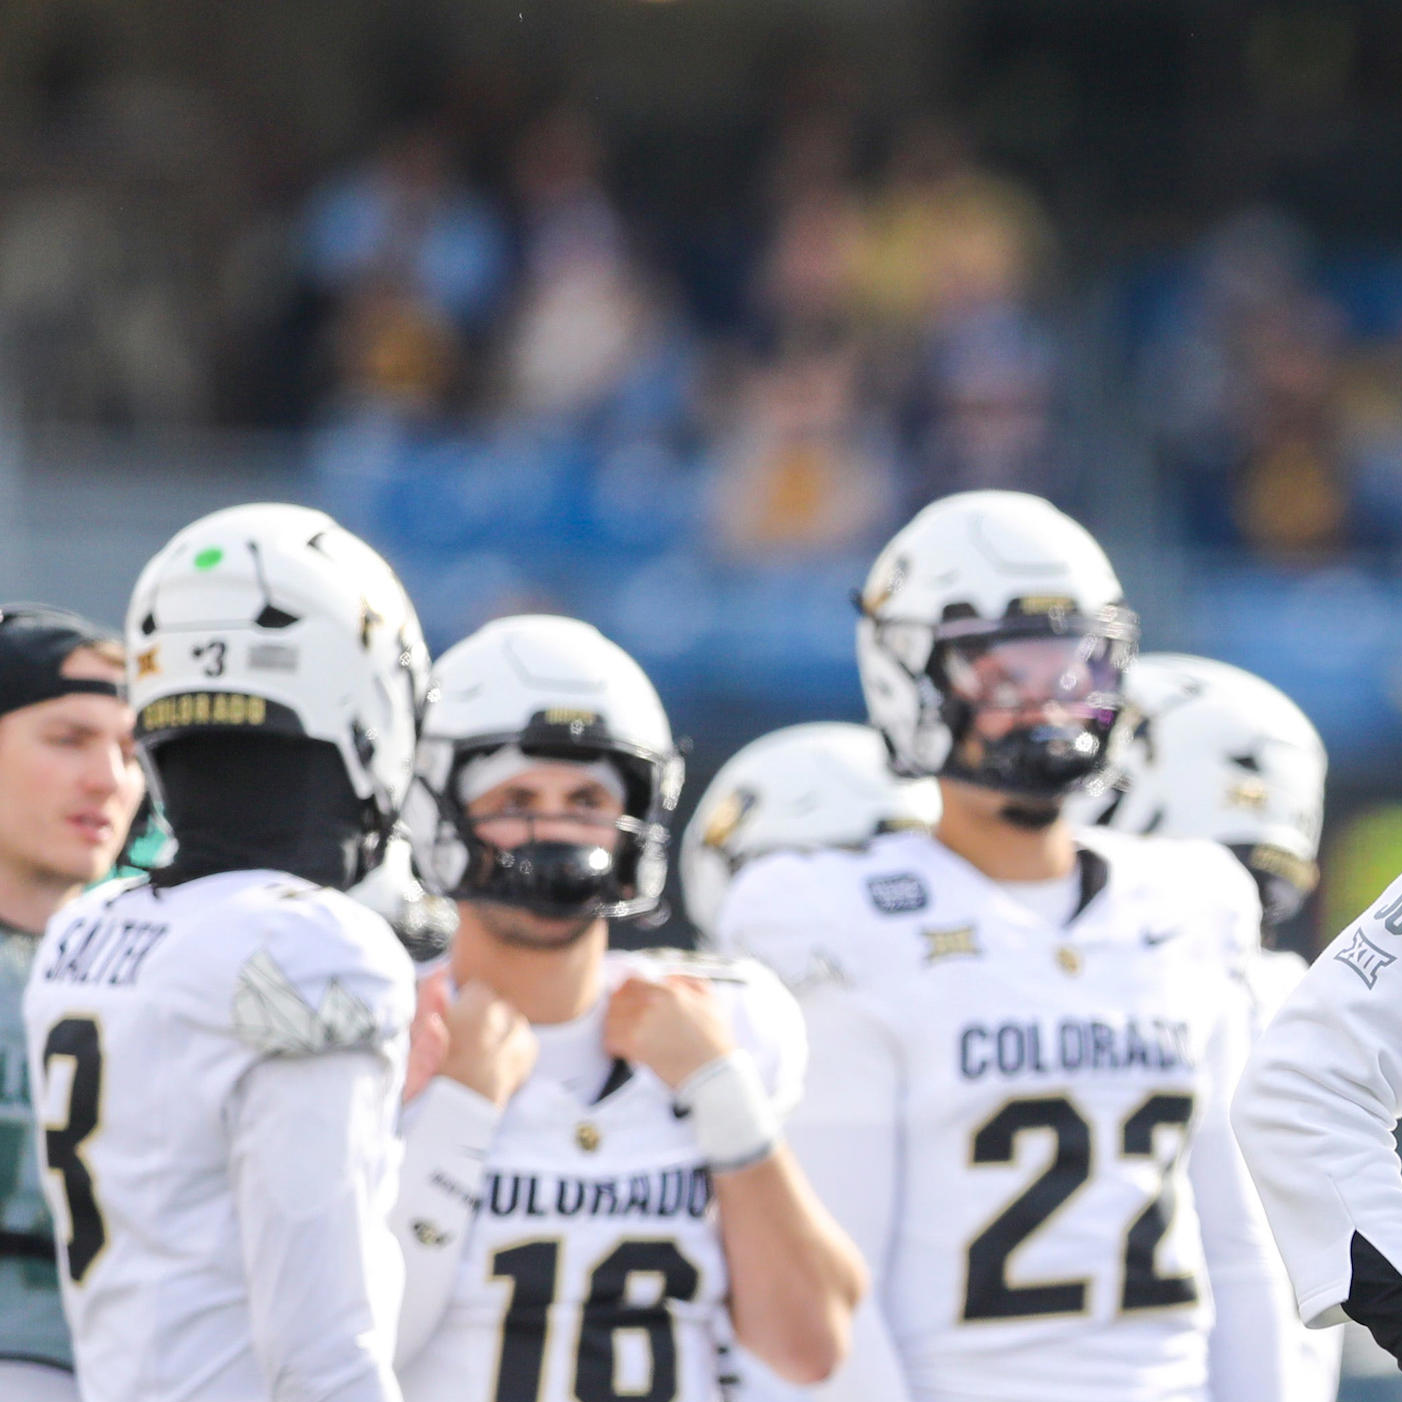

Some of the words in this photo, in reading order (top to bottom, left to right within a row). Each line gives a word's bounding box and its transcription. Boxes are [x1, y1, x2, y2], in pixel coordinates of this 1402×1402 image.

[203, 641, 228, 677] 3
[44, 915, 171, 985] SALTER
[486, 1163, 713, 1219] OLORADO
[957, 1087, 1202, 1328] 22
